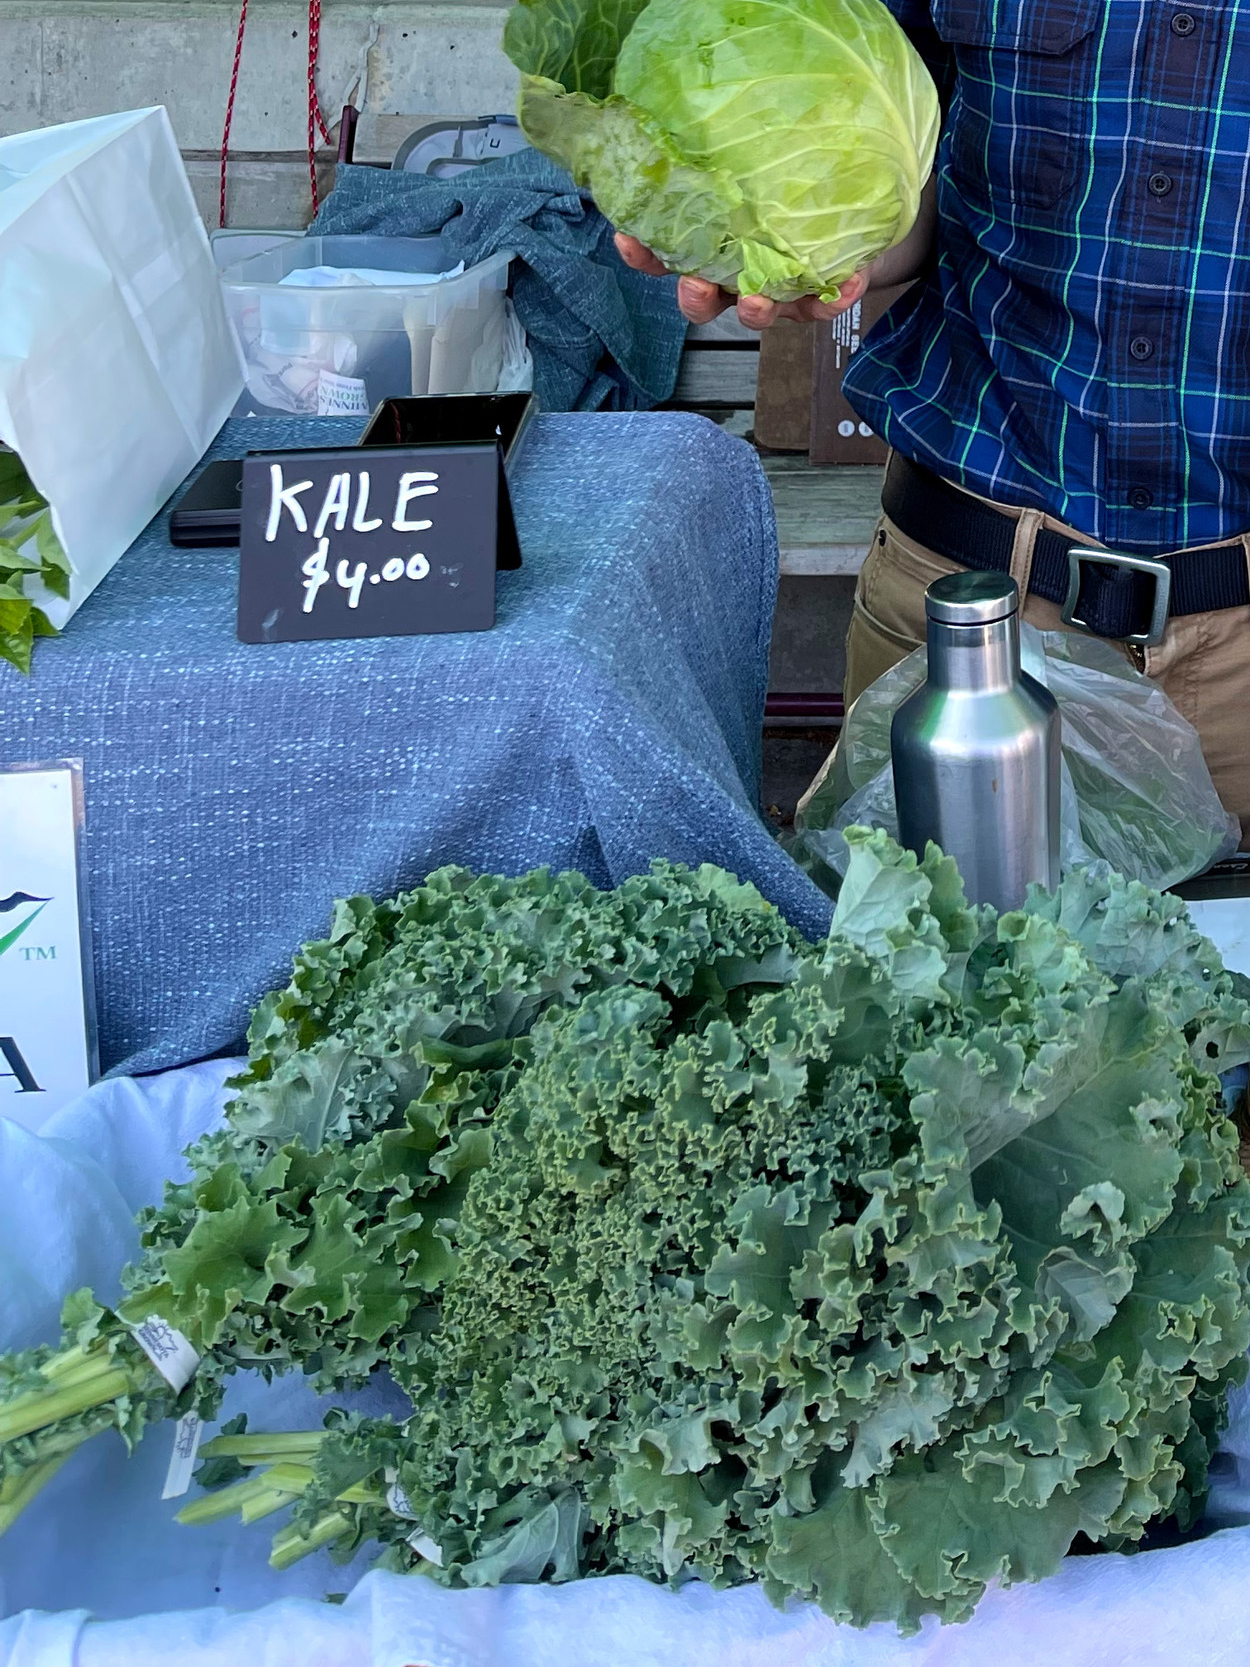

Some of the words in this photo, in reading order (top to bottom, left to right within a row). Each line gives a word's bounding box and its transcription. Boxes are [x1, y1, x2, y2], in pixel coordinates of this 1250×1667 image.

[265, 464, 439, 542] KALE
[302, 537, 430, 613] $4.00
[19, 945, 57, 961] TM
